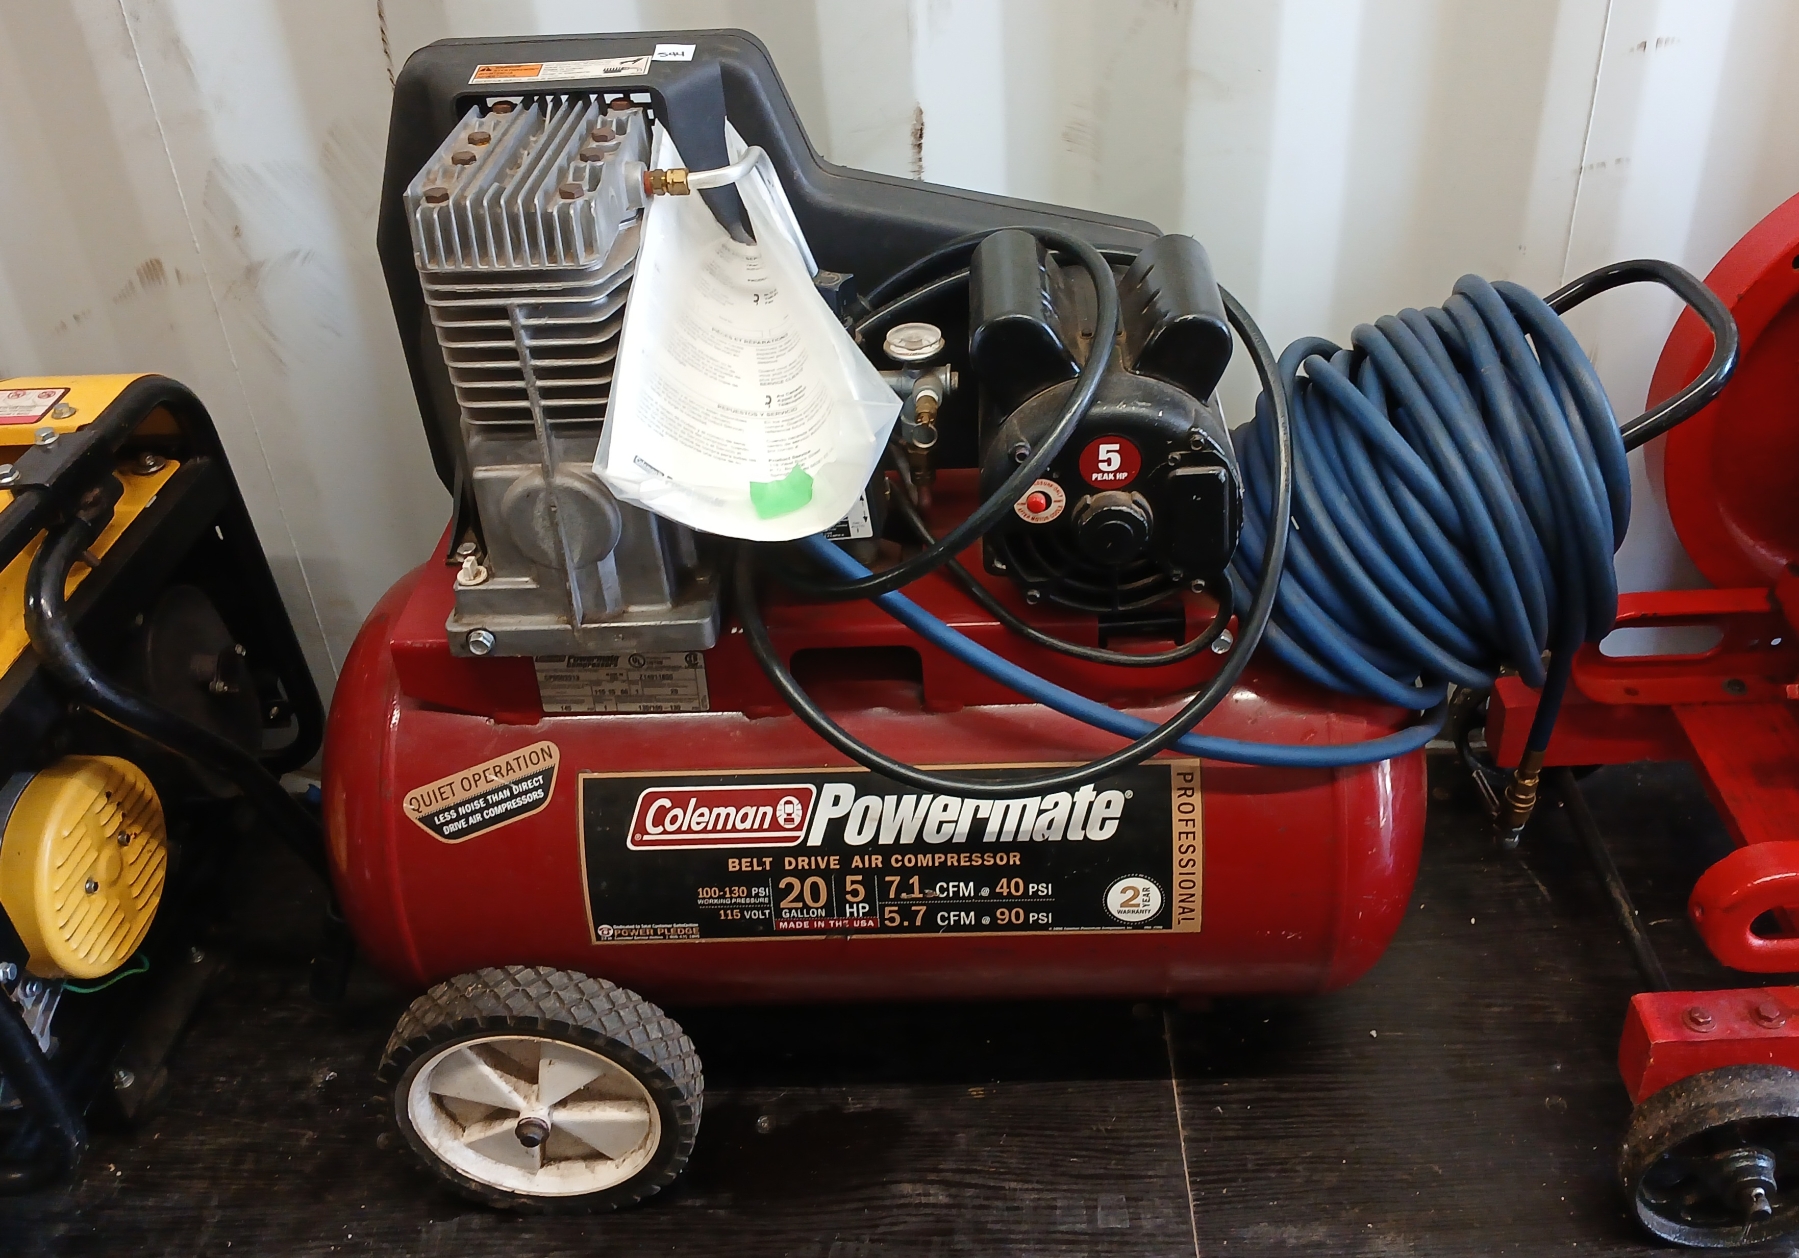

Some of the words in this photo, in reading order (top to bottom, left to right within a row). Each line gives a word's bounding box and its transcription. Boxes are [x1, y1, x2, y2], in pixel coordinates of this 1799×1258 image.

[1098, 443, 1121, 472] 5
[1091, 472, 1115, 481] PEAK
[1115, 472, 1129, 480] HP
[409, 781, 456, 814] QUIET
[460, 744, 553, 792] OPERATION
[434, 808, 457, 825] LESS
[458, 799, 487, 816] NOISE
[487, 788, 511, 805] THAN
[512, 775, 544, 794] DIRECT
[442, 818, 468, 836] DRIVE
[468, 811, 483, 826] AIR
[483, 788, 545, 820] COMPRESSORS
[645, 797, 774, 835] Coleman
[1176, 771, 1197, 925] PROFESSIONAL
[728, 857, 773, 872] BELT
[784, 855, 841, 870] DRIVE
[851, 854, 883, 869] AIR
[890, 852, 1021, 868] COMPRESSOR
[697, 886, 748, 898] 100-130
[751, 887, 769, 897] PSI
[778, 876, 828, 908] 20
[845, 875, 866, 903] 5
[884, 875, 924, 899] 7.1
[935, 881, 975, 898] CFM
[980, 886, 990, 897] @
[995, 877, 1025, 896] 40
[1028, 883, 1052, 896] PSI
[1119, 885, 1141, 908] 2
[1141, 886, 1151, 908] YEAR
[719, 909, 741, 920] 115
[743, 909, 771, 919] VOLT
[781, 908, 826, 919] GALLON
[845, 903, 870, 917] HP
[884, 905, 927, 927] 5.7
[936, 911, 975, 926] CFM
[981, 915, 991, 925] @
[995, 908, 1025, 925] 90
[1029, 912, 1052, 924] PSI
[614, 928, 654, 936] POWER
[657, 927, 700, 936] PLEDGE
[779, 920, 810, 929] MADE
[813, 920, 825, 928] IN
[853, 919, 875, 928] USA
